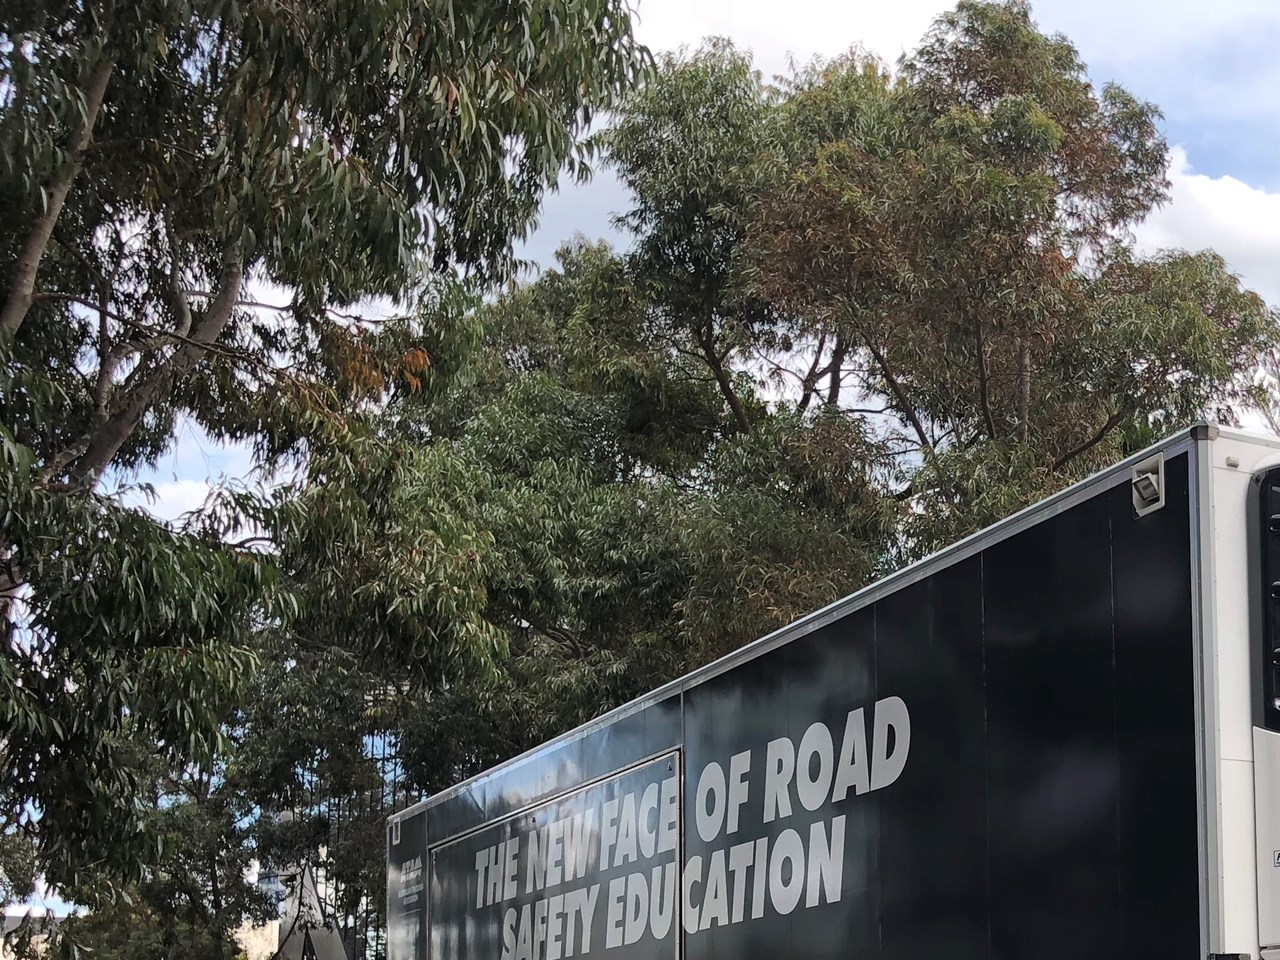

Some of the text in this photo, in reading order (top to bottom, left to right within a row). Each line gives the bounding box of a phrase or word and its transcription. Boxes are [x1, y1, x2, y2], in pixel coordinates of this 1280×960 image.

[475, 696, 911, 909] THE NEW FACE OF ROAD
[605, 815, 847, 950] EDUCATION
